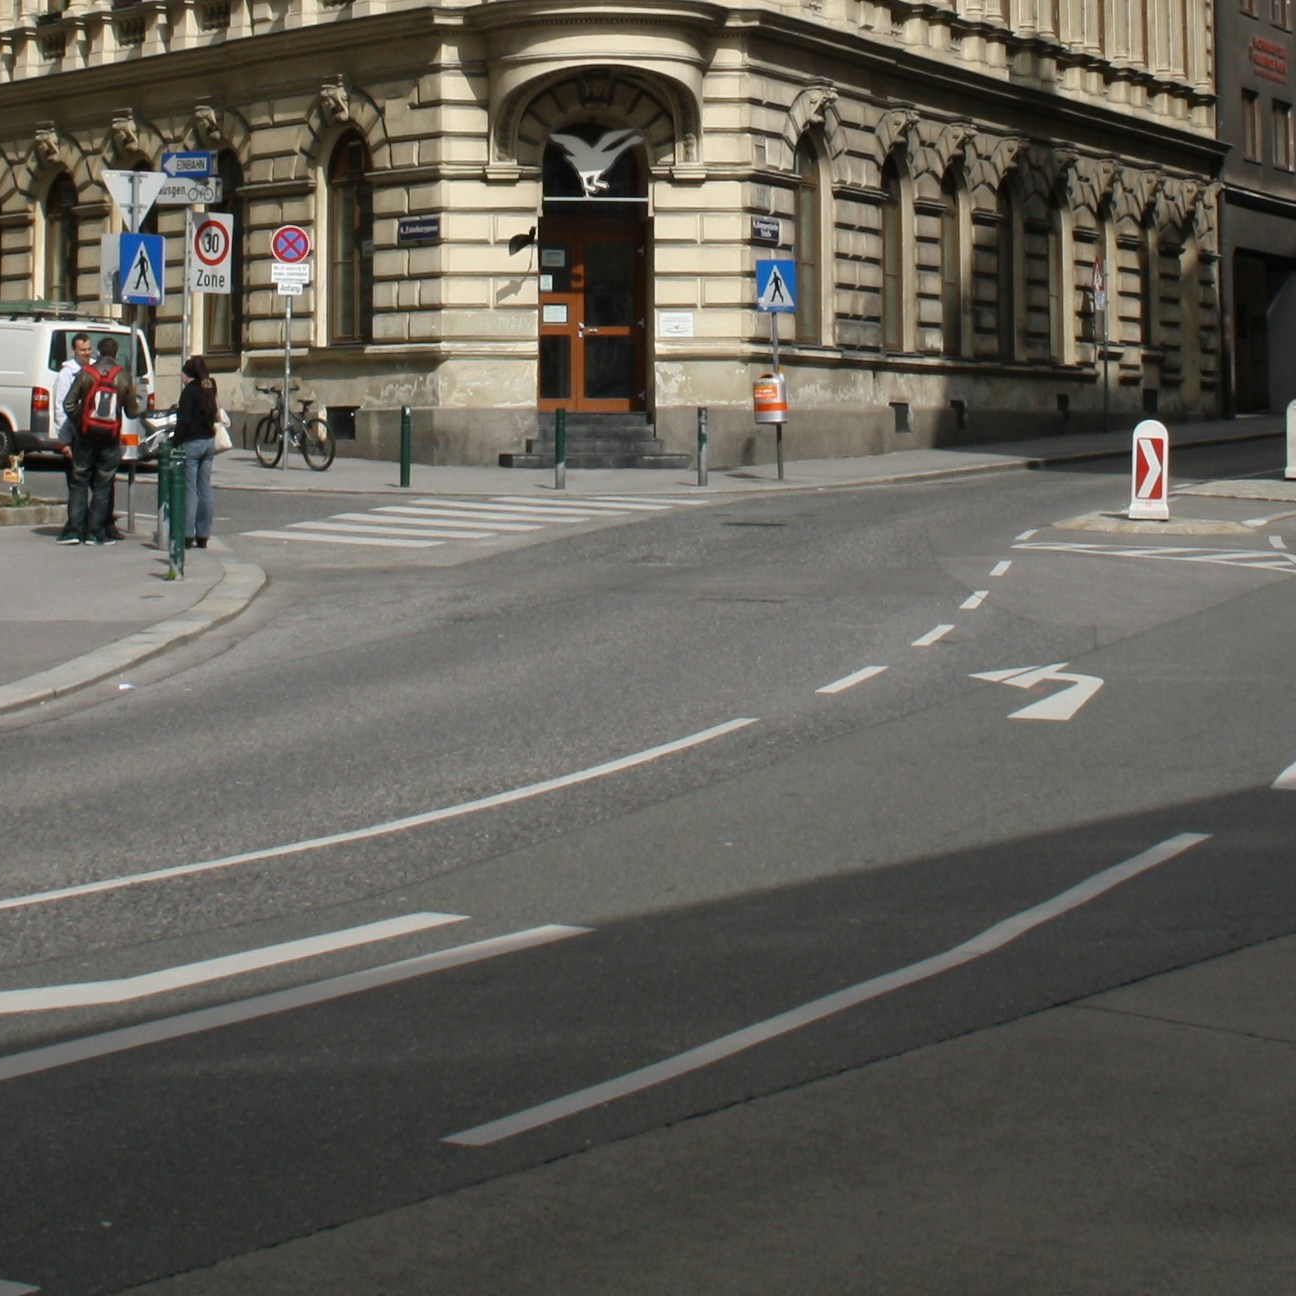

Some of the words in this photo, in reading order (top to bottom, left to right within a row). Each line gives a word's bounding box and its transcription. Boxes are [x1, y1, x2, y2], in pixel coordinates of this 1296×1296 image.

[176, 159, 206, 170] EINBAHN
[204, 234, 220, 253] 30
[196, 269, 225, 287] Zone
